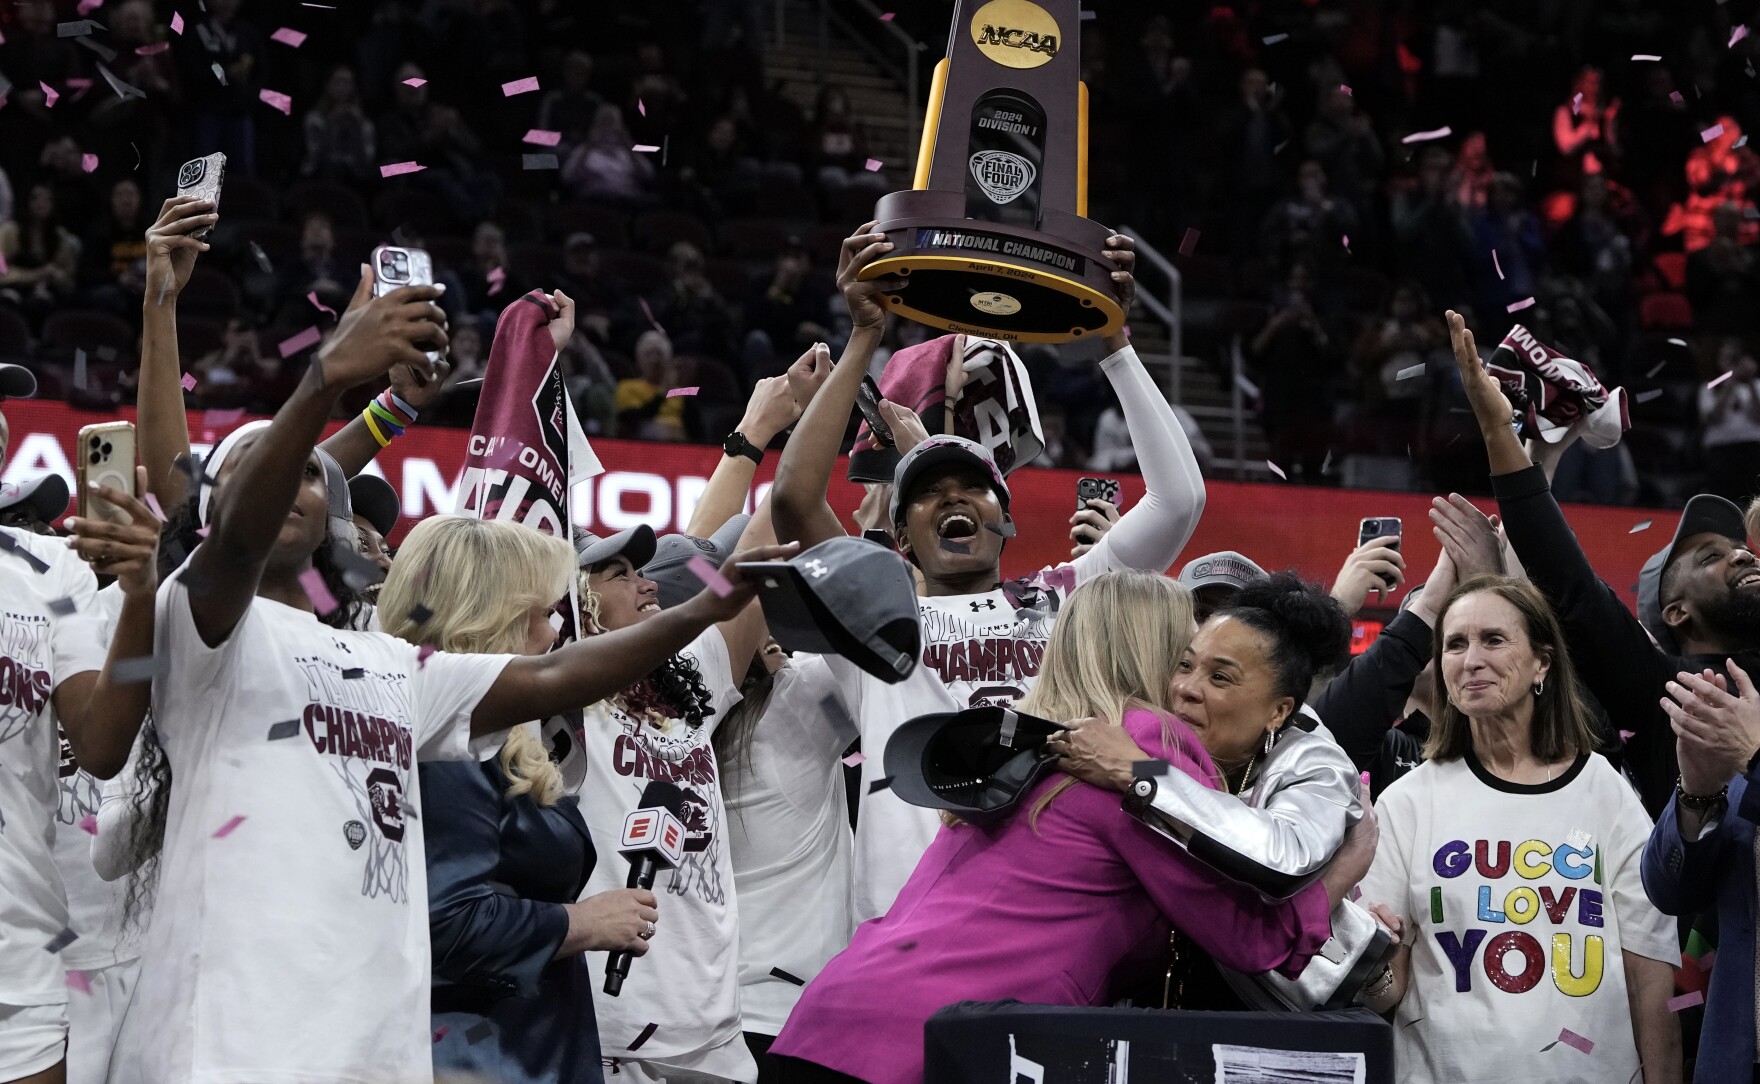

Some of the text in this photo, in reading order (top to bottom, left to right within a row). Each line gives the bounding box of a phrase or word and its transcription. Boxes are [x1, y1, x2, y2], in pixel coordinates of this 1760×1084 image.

[977, 24, 1058, 58] NCAA
[978, 117, 1038, 136] DIVISION I
[994, 110, 1023, 123] 2024
[984, 160, 1021, 176] FINAL
[983, 171, 1020, 188] FOUR
[932, 233, 1076, 271] NATIONAL CHAMPION
[968, 262, 1036, 280] April 7, 2024
[947, 322, 1018, 341] Cleveland, OH
[629, 818, 651, 839] E
[1432, 839, 1602, 885] GUCCI
[1431, 885, 1605, 928] I LOVE
[1434, 929, 1604, 997] YOU
